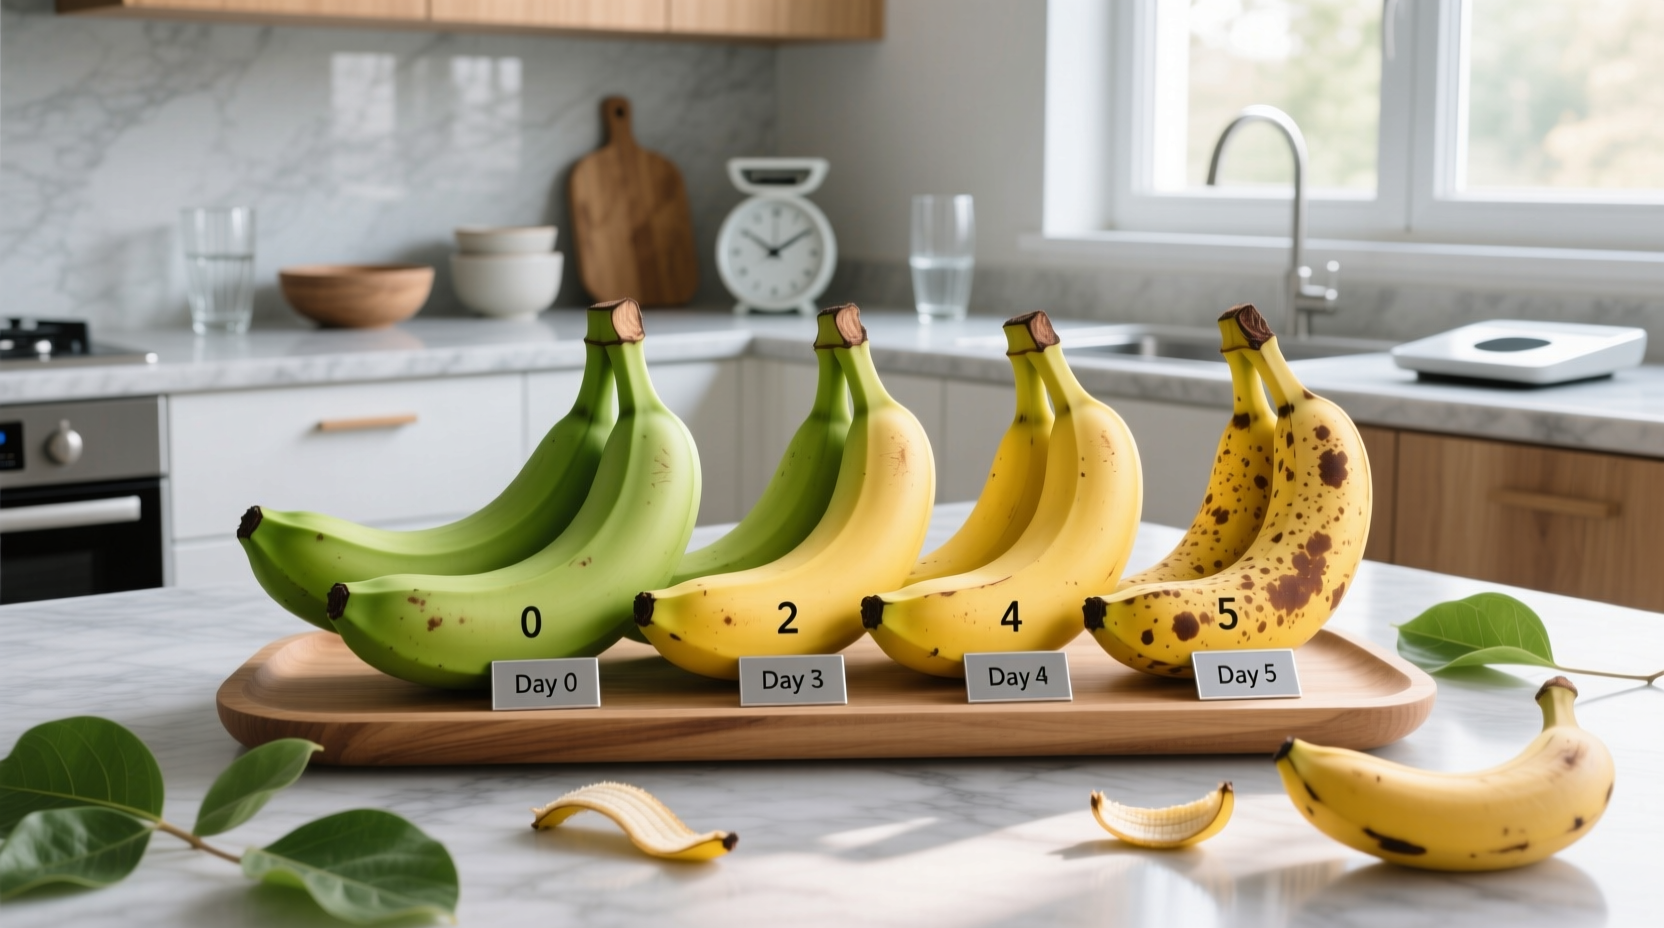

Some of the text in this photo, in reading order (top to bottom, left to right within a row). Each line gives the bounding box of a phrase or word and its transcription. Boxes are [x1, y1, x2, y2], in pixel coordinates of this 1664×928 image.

[520, 605, 542, 639] 0
[777, 601, 799, 634] 2
[1000, 600, 1023, 632] 4
[1218, 597, 1238, 630] 5
[515, 671, 578, 699] Day 0
[762, 668, 824, 695] Day 3
[988, 665, 1049, 692] Day 4
[1217, 663, 1277, 689] Day 5
